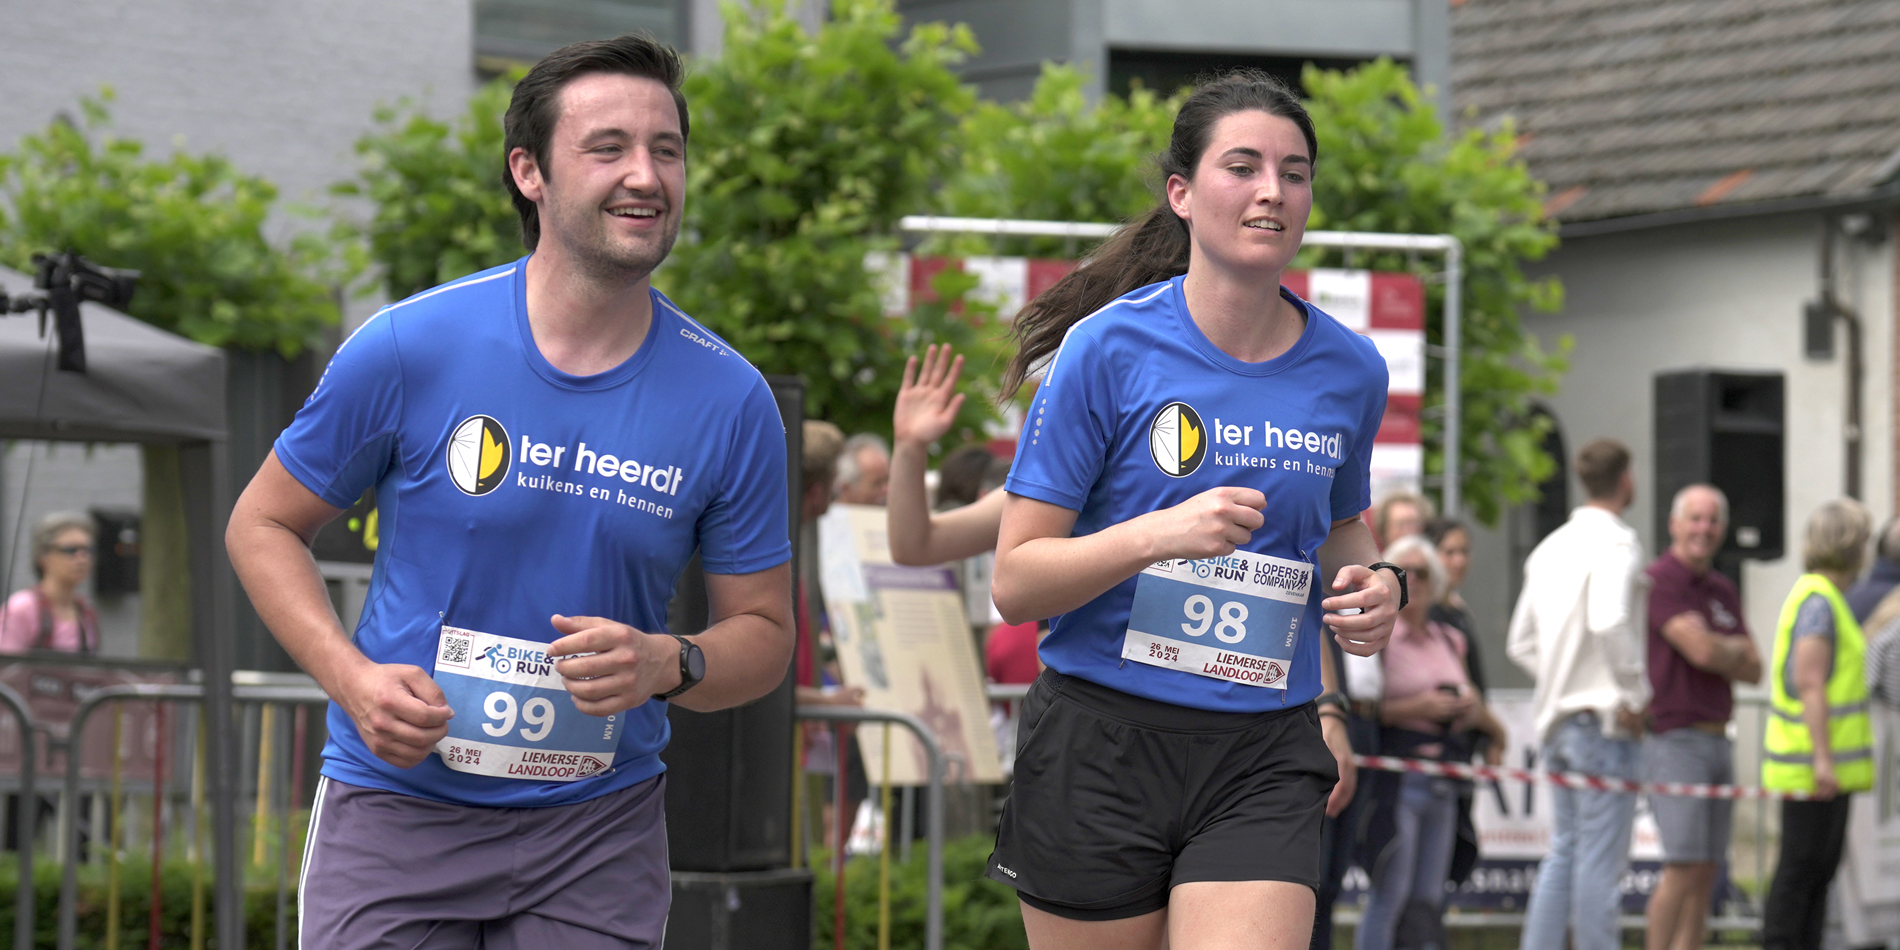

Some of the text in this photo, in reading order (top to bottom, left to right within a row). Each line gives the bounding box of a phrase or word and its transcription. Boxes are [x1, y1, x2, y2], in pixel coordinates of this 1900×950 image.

[680, 328, 720, 351] CRAFT
[1214, 417, 1254, 446] ter
[519, 434, 683, 496] ter heerdt
[1215, 451, 1334, 478] kuikens en henn
[517, 471, 674, 519] kuikens en hennen
[1208, 557, 1249, 572] BIKE&
[1214, 566, 1245, 582] RUN
[1255, 561, 1299, 580] LOPERS
[1253, 573, 1298, 590] COMPANY
[1181, 594, 1249, 644] 98
[1284, 616, 1298, 647] 10 KM
[507, 646, 555, 665] BIKE&
[1148, 649, 1178, 662] 2024
[1150, 642, 1180, 655] 26 MEI
[516, 660, 551, 676] RUN
[1216, 652, 1268, 671] LIEMERSE
[1203, 662, 1264, 683] LANDLOOP
[481, 691, 555, 742] 99
[603, 724, 614, 740] KM
[448, 753, 481, 766] 2024
[449, 745, 482, 757] 26 MEI
[521, 751, 580, 766] LIEMERSE
[508, 763, 576, 778] LANDLOOP
